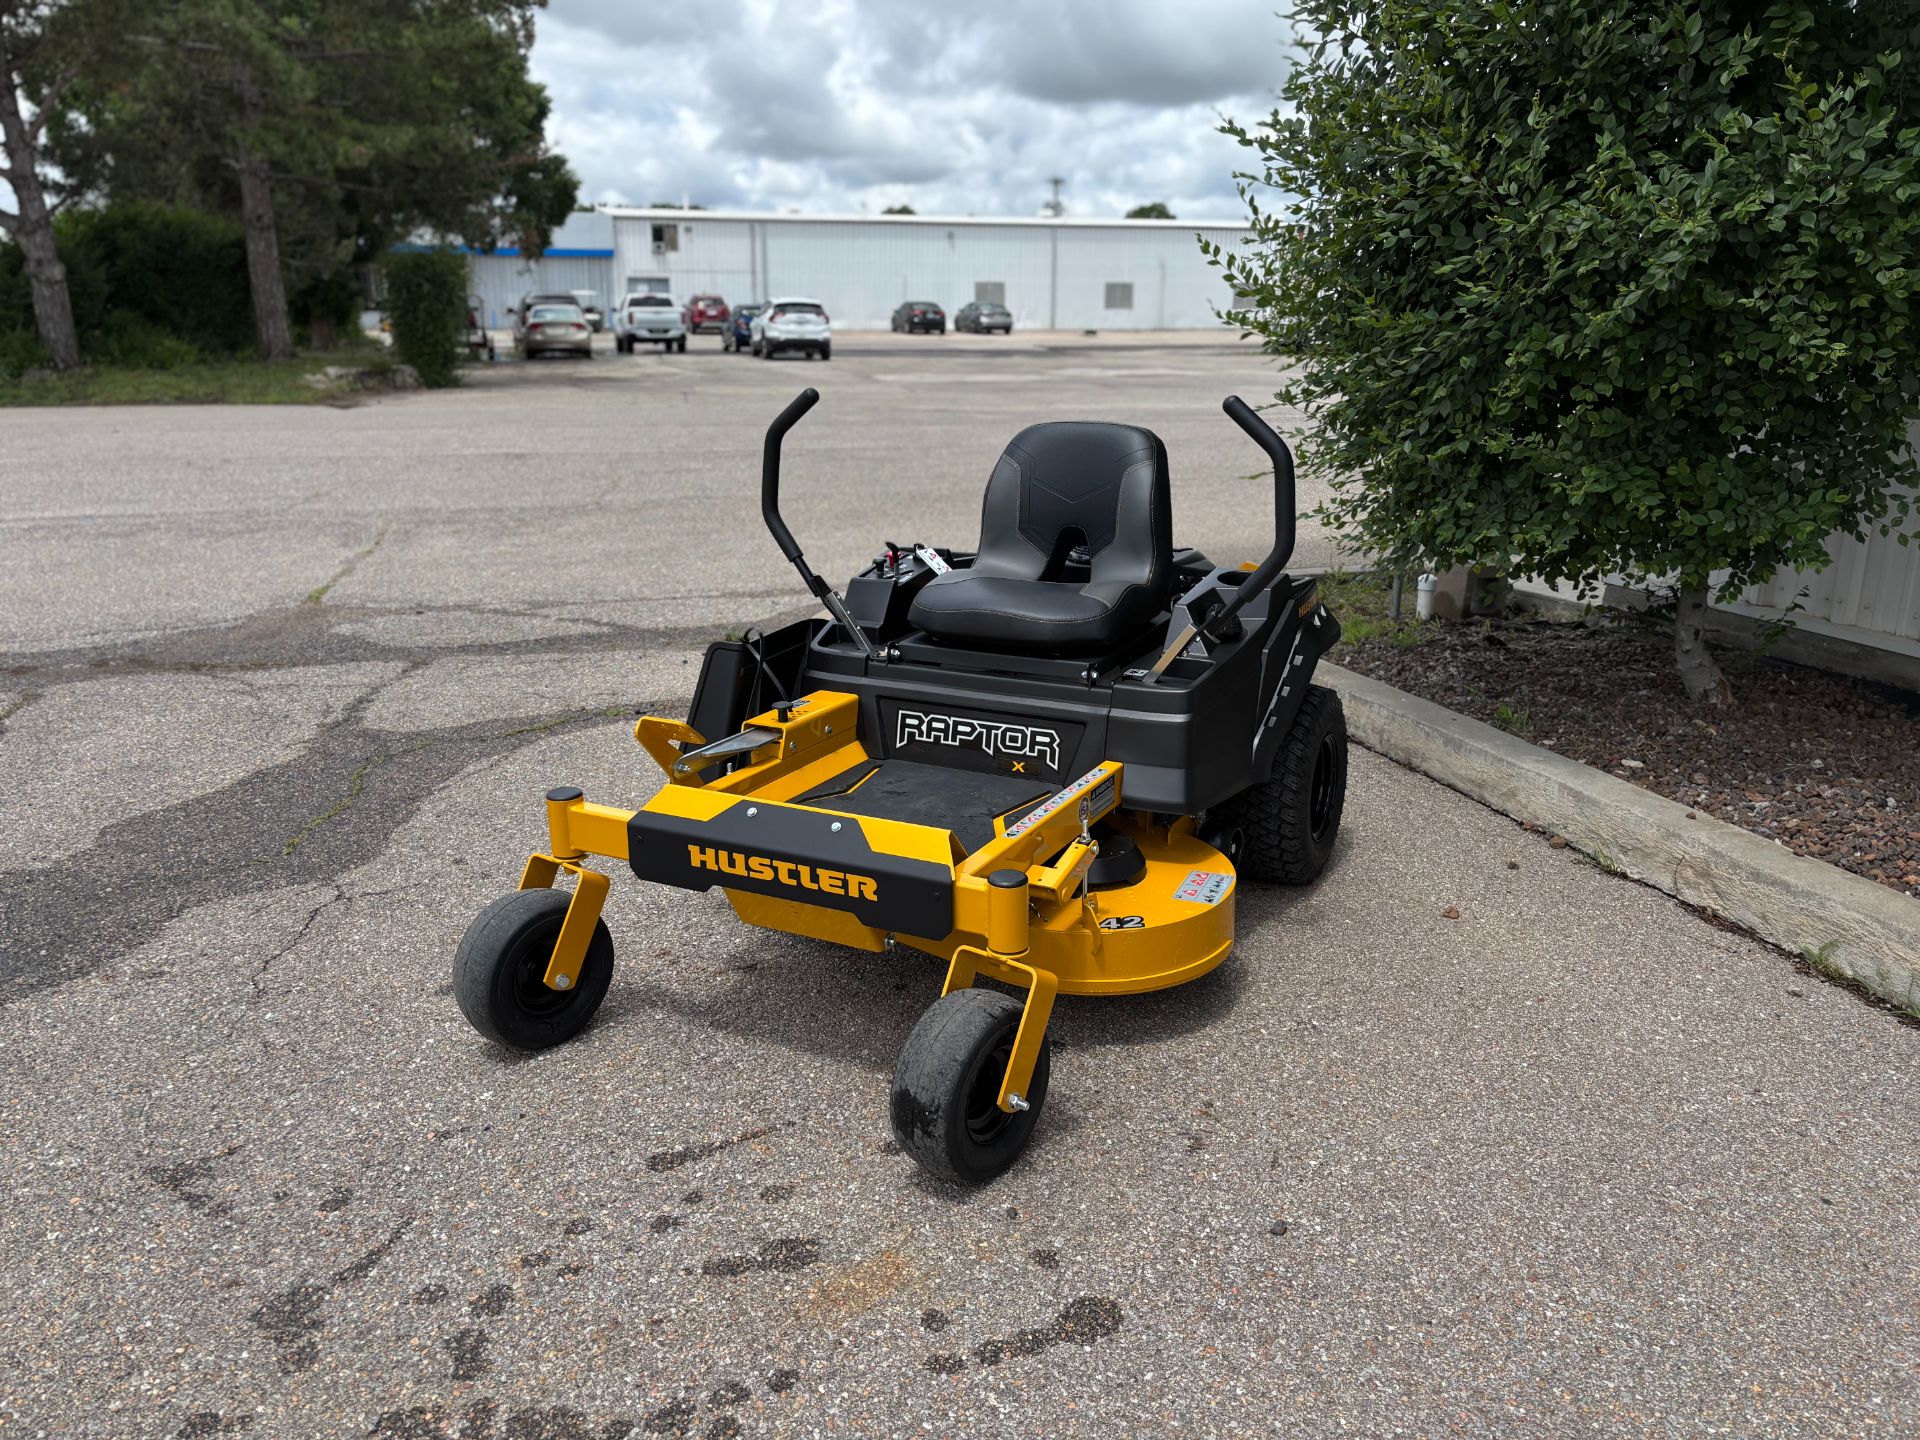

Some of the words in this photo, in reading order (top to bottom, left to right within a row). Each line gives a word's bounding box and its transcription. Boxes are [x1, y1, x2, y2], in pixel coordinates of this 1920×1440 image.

[896, 710, 1060, 771] RAPTOR
[1011, 760, 1026, 773] X
[687, 844, 878, 902] HUSTLER
[1099, 915, 1146, 929] 42
